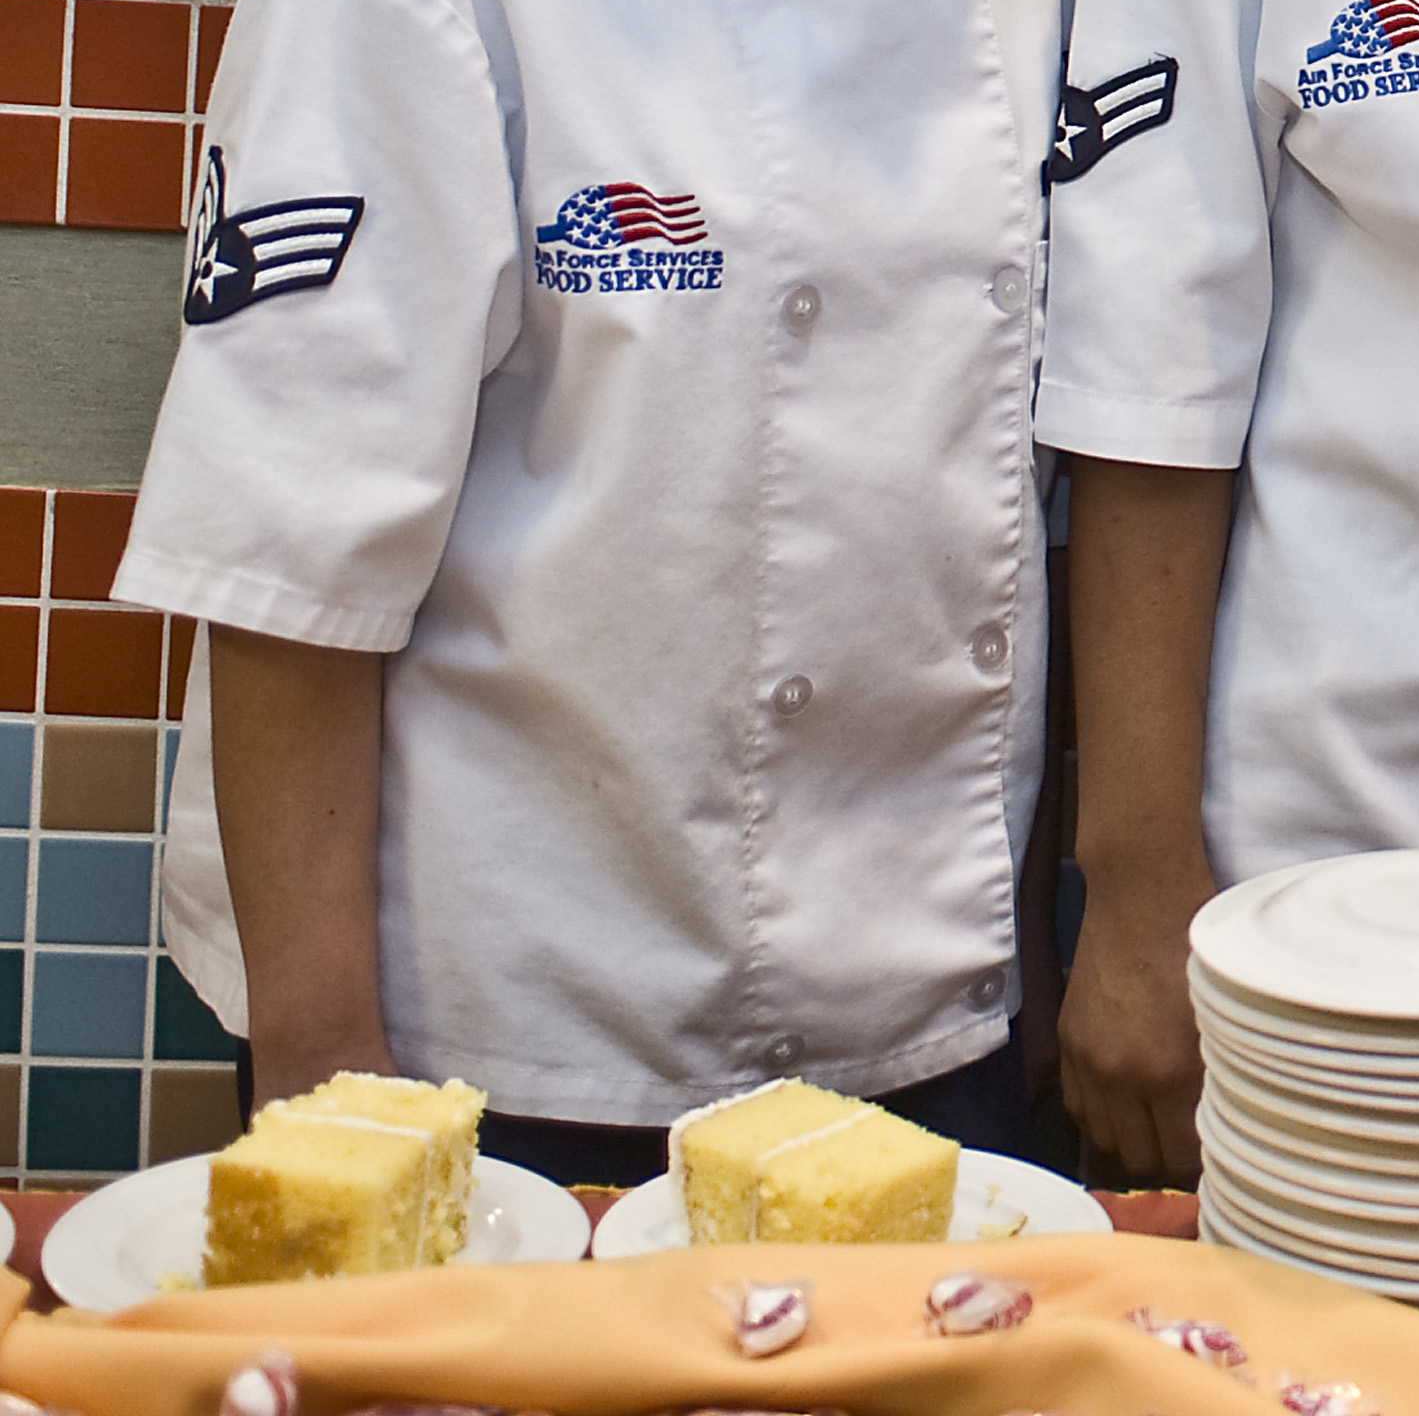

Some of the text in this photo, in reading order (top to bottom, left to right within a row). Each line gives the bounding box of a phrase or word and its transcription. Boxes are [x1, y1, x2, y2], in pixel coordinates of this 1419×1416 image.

[1298, 69, 1327, 87] AIR
[1331, 58, 1393, 81] FORCE
[1298, 79, 1370, 109] FOOD
[556, 251, 622, 269] FORCE
[628, 249, 724, 267] SERVICES
[536, 263, 723, 293] FOOD SERVICE
